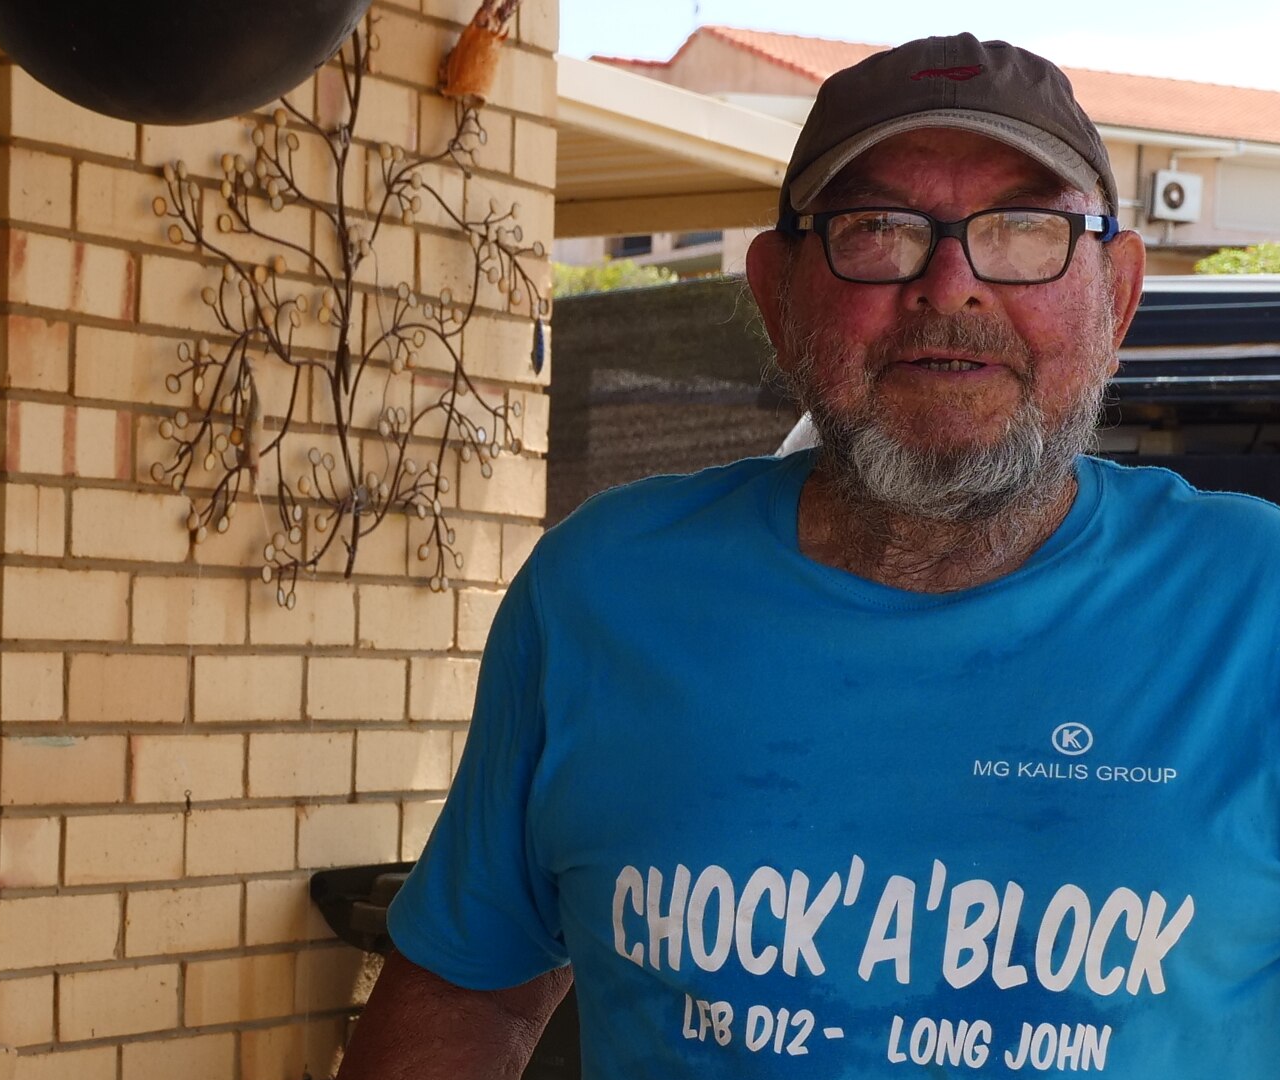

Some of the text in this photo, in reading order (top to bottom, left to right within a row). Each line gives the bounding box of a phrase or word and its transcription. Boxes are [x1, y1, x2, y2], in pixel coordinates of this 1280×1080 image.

[973, 759, 1177, 783] MG KAILIS GROUP
[681, 994, 734, 1047] LFB
[745, 1004, 815, 1057] D12
[887, 1014, 994, 1070] LONG
[1004, 1020, 1113, 1072] JOHN
